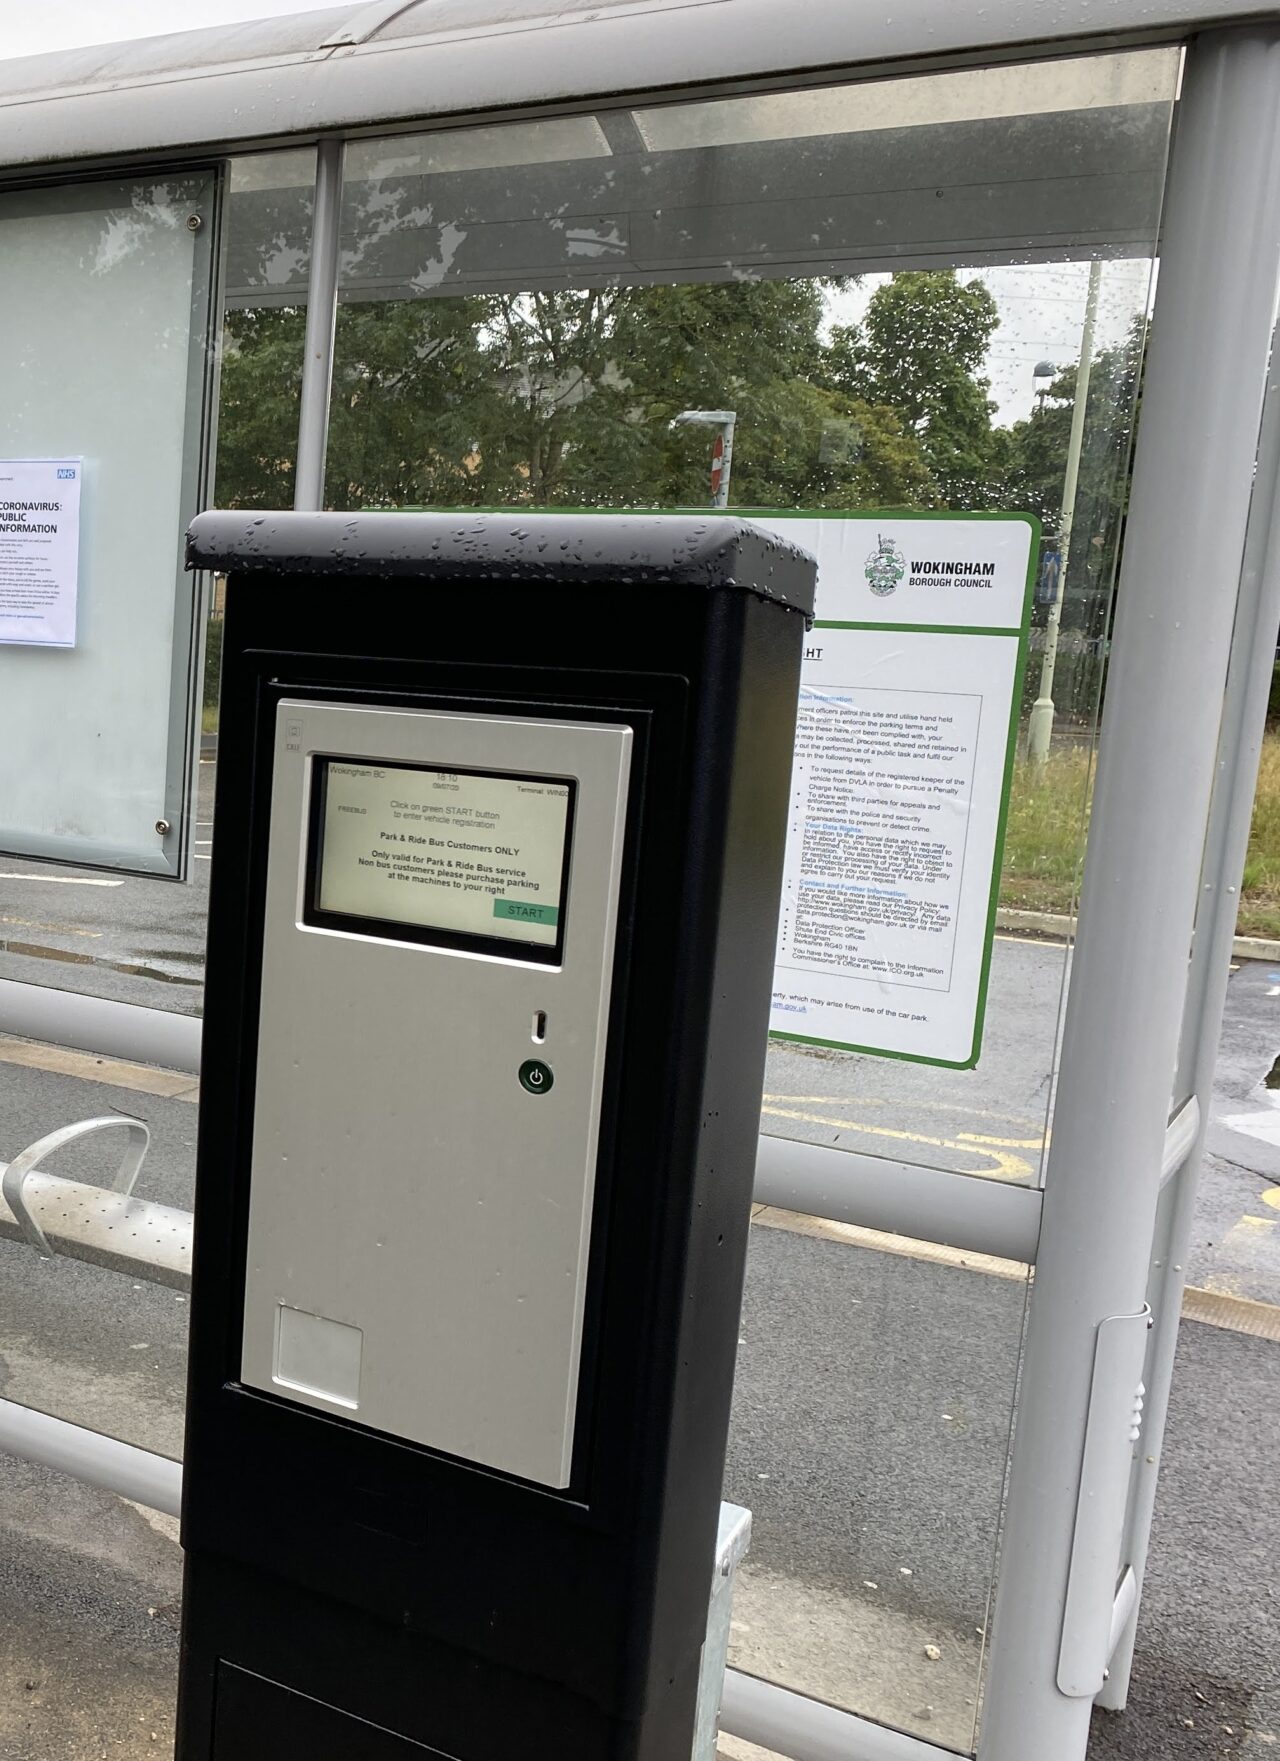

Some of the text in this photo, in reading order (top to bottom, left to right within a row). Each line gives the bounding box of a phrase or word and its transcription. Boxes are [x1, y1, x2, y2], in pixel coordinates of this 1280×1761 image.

[57, 469, 75, 479] NHS
[911, 562, 995, 575] WOKINGHAM
[909, 578, 992, 588] BOROUGH COUNCIL
[880, 722, 903, 730] parking
[826, 754, 852, 762] following
[330, 766, 386, 778] Wokingham BC
[922, 776, 944, 784] keeper
[390, 800, 408, 810] Click
[422, 805, 443, 813] green
[446, 807, 473, 816] START
[476, 810, 500, 819] button
[424, 815, 450, 824] vehicle
[453, 818, 495, 829] registration
[381, 832, 397, 840] Park
[408, 835, 426, 844] Ride
[429, 838, 444, 847] Bus
[447, 840, 492, 853] Customers
[495, 847, 519, 855] ONLY
[372, 850, 390, 860] Only
[392, 854, 410, 862] valid
[427, 857, 444, 866] Park
[456, 861, 474, 870] Ride
[477, 864, 493, 873] Bus
[496, 867, 526, 877] service
[358, 858, 539, 890] Non bus customers please purchase parking
[397, 873, 409, 881] the
[412, 876, 450, 887] machines
[464, 883, 483, 891] your
[485, 885, 505, 895] right
[508, 906, 544, 918] START
[812, 922, 842, 930] Protection
[794, 932, 830, 941] Wokingham
[790, 994, 808, 1003] which
[810, 998, 824, 1006] may
[845, 1003, 860, 1011] from
[886, 1009, 896, 1017] the
